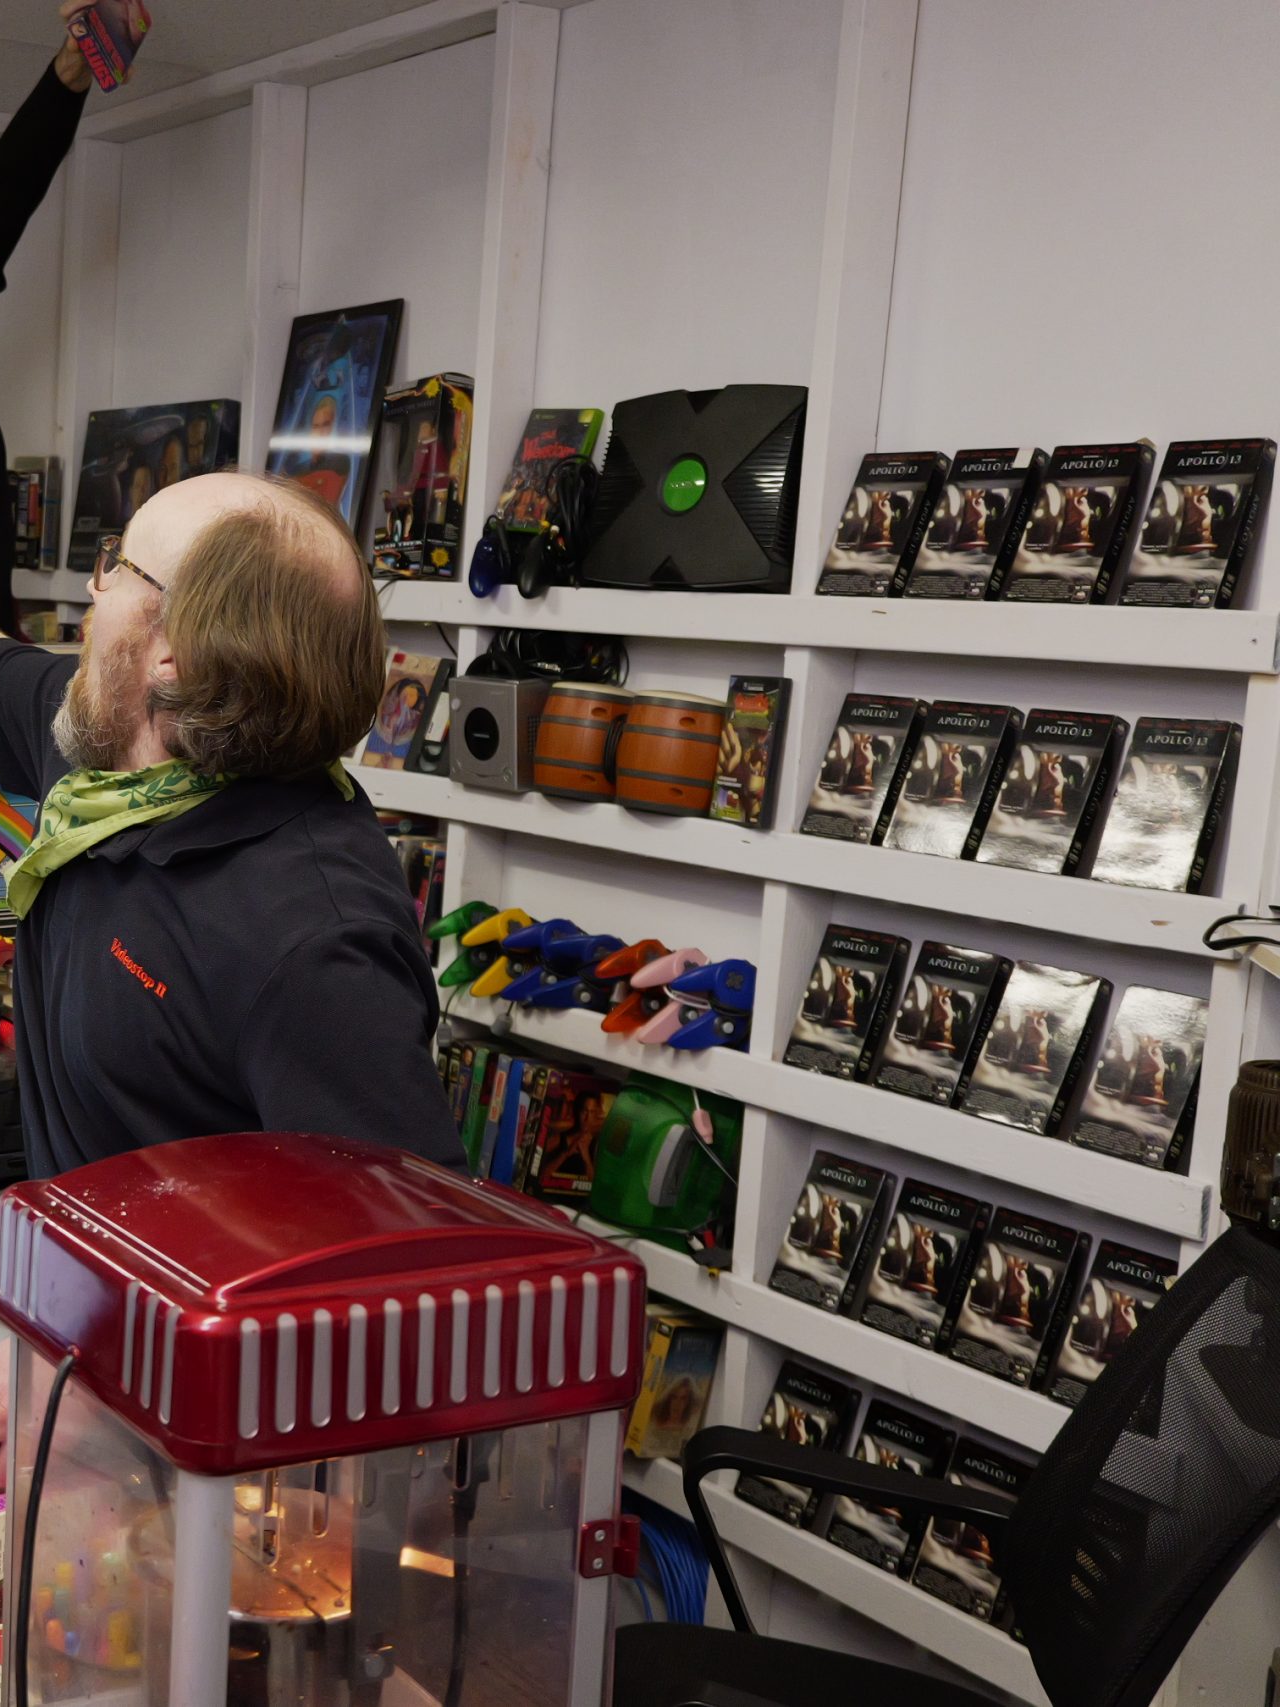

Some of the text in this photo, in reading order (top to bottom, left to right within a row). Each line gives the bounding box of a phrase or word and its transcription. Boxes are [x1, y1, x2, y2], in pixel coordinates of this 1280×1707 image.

[1060, 458, 1119, 470] APOLLO 13
[1177, 455, 1242, 466] APOLLO 13
[869, 465, 918, 476] APOLLO 13
[961, 462, 1001, 472] APOLLO
[851, 708, 899, 719] APOLLO 13
[937, 717, 990, 728] APOLLO 13
[1035, 725, 1093, 737] APOLLO 13
[1146, 735, 1208, 746] APOLLO 13
[832, 940, 879, 954] APOLLO 13
[928, 958, 980, 974] APOLLO 13
[819, 1167, 867, 1188] APOLLO 13
[909, 1196, 960, 1218] APOLLO 13
[1002, 1225, 1057, 1249] APOLLO 13
[1106, 1260, 1153, 1281] APOLLO
[964, 1458, 1004, 1480] APOLLO
